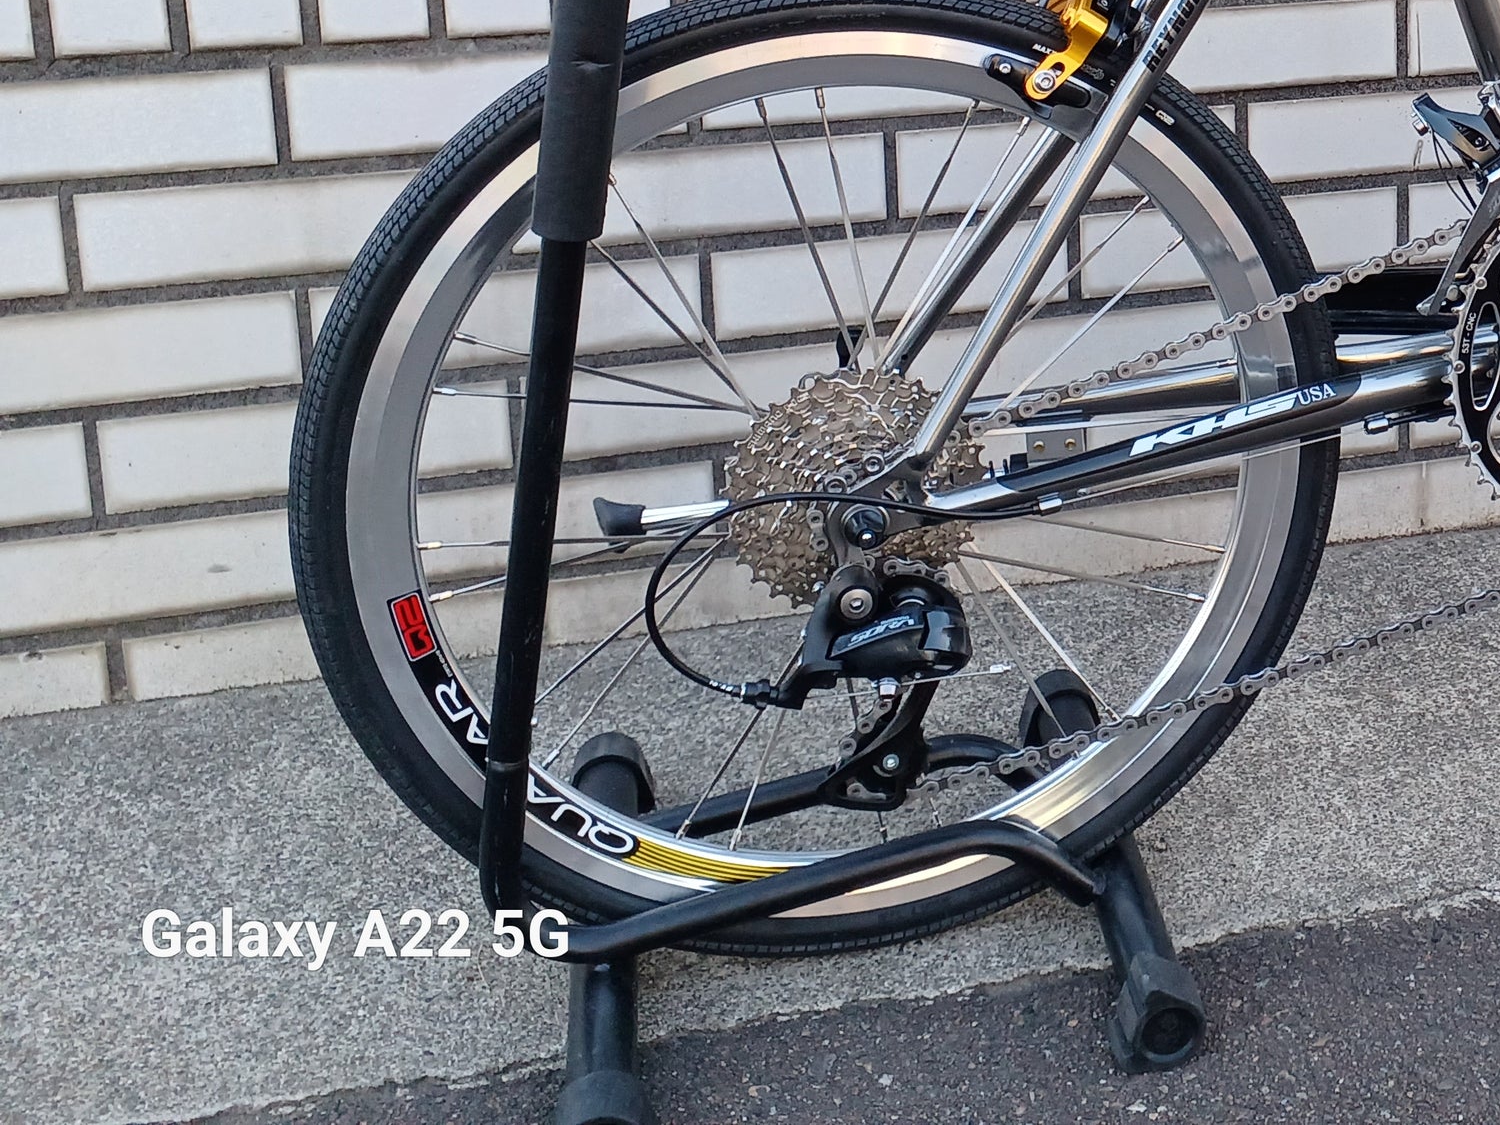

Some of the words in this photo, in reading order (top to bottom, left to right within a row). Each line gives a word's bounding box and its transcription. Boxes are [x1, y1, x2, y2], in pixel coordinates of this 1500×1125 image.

[1465, 312, 1477, 331] CNC
[1462, 338, 1470, 354] 53T
[1129, 392, 1298, 457] KHS
[1297, 383, 1337, 405] USA
